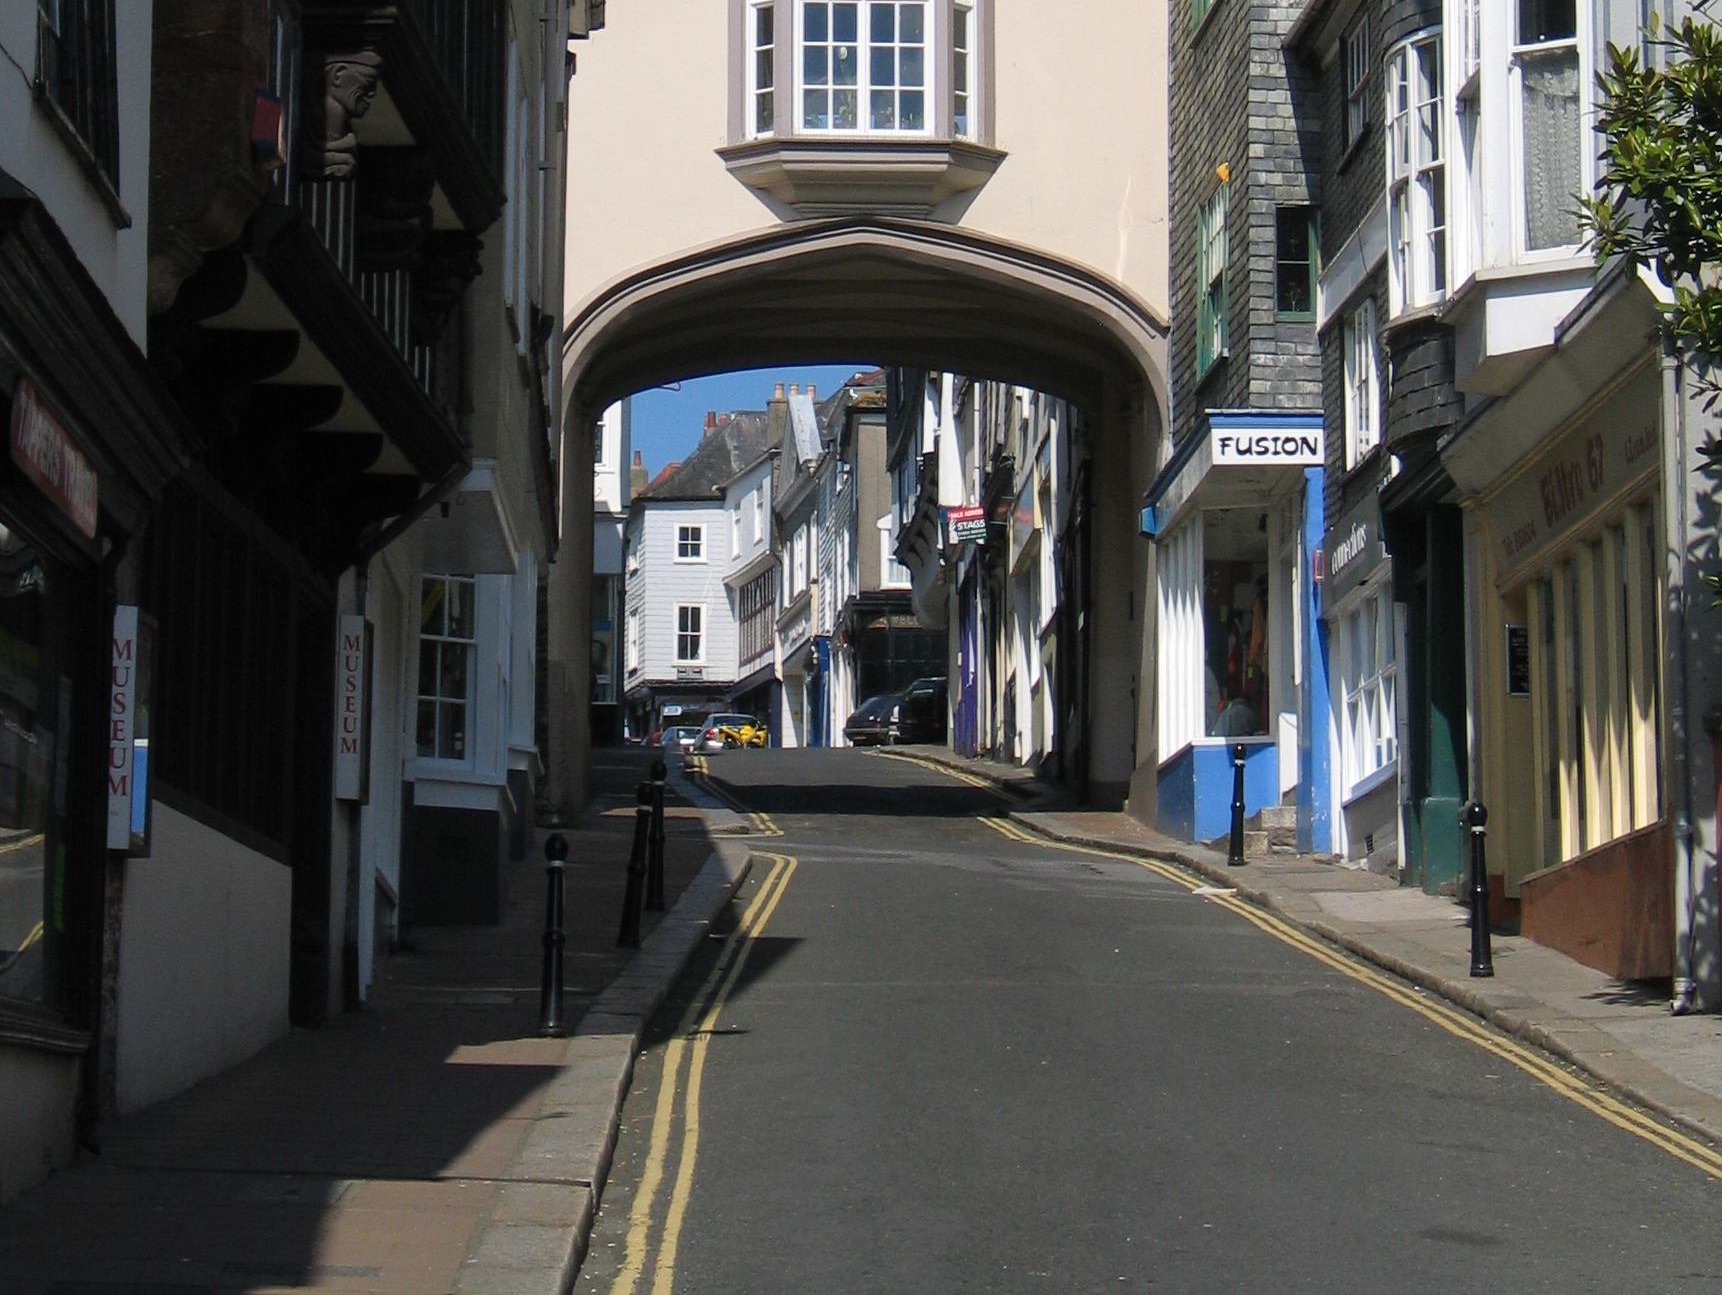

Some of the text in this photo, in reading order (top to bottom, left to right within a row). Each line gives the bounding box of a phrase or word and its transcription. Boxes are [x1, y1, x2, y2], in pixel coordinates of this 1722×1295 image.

[1218, 436, 1318, 457] FUSION
[1586, 431, 1604, 494] 67
[109, 637, 133, 798] MUSEUM
[340, 634, 361, 755] MUSEUM
